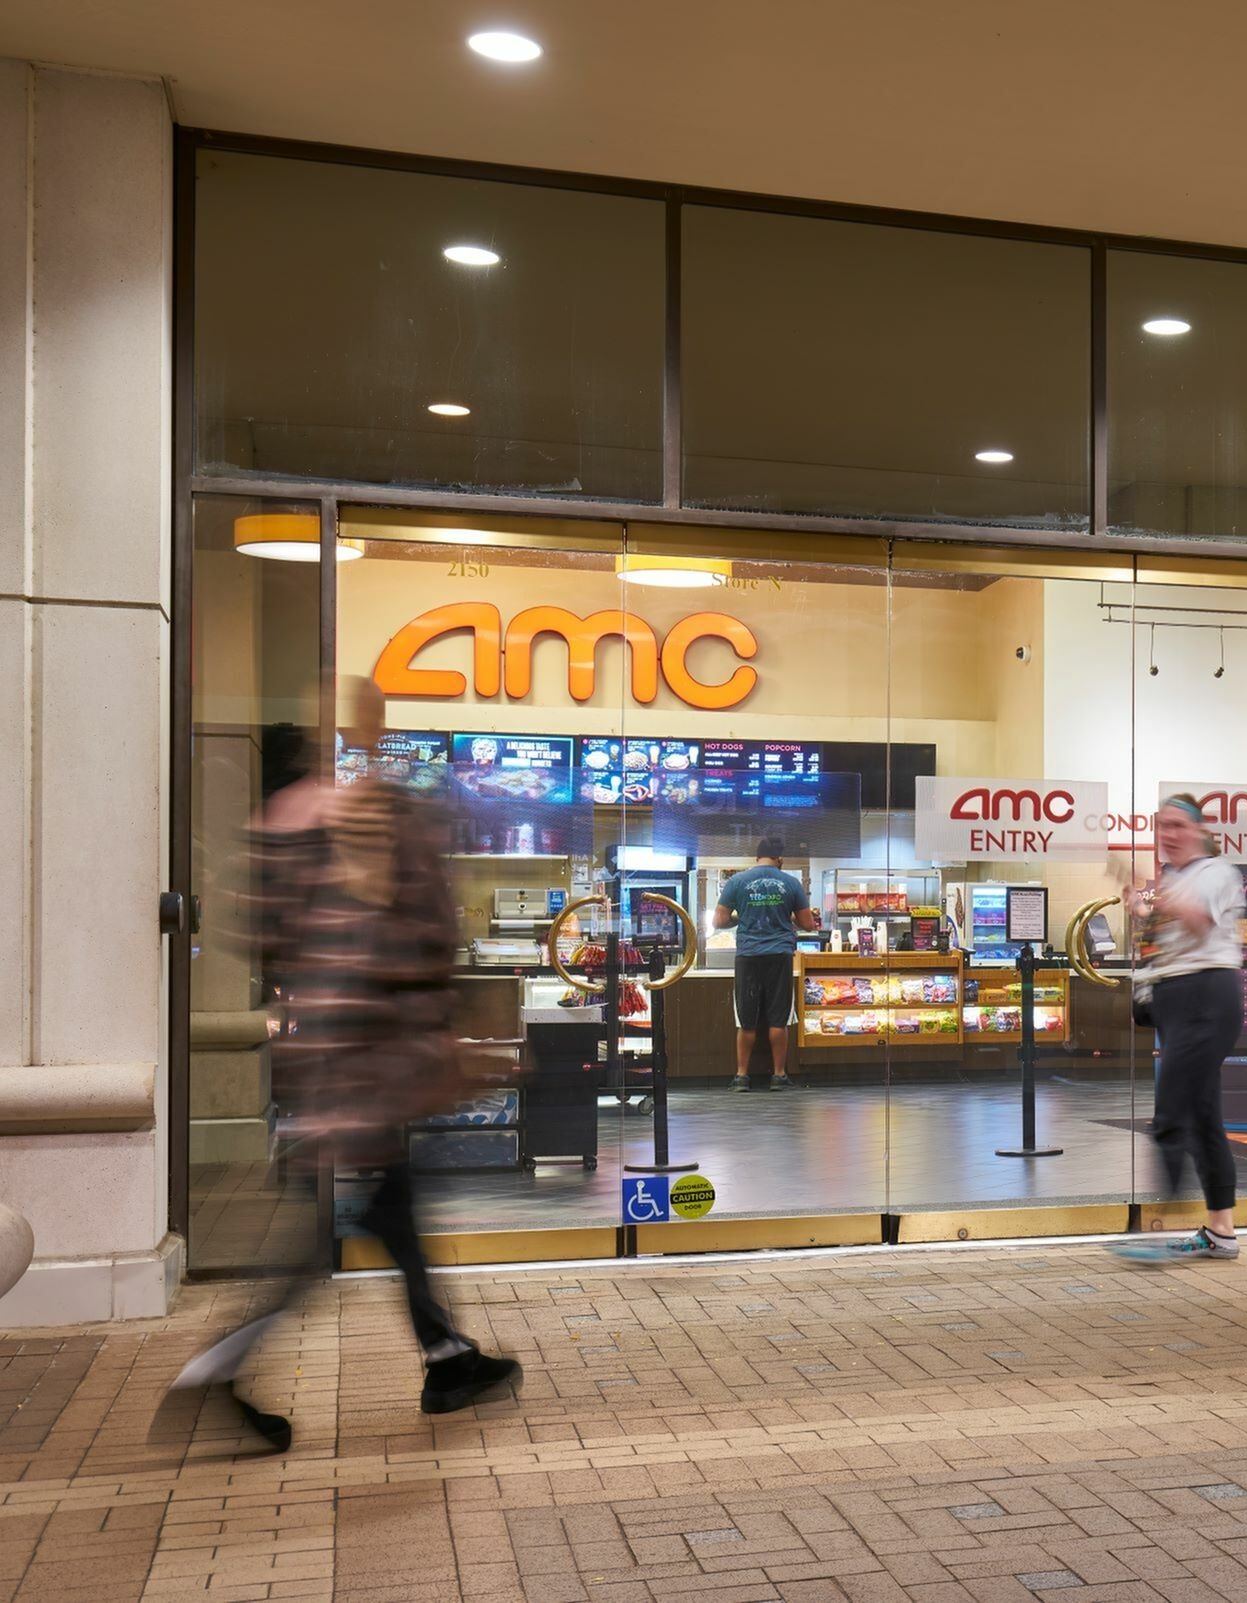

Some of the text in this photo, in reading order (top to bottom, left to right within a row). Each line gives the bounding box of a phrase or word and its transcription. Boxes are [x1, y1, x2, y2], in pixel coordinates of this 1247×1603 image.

[447, 561, 489, 578] 2150
[712, 573, 758, 590] Store
[378, 742, 417, 751] LATBREAD
[722, 743, 743, 751] DOGS
[765, 744, 801, 752] POPCORN
[1083, 814, 1155, 832] CONDI
[970, 829, 1053, 853] ENTRY
[675, 1183, 709, 1191] AUTOMATIC
[672, 1191, 713, 1203] CAUTION
[684, 1203, 702, 1211] DOOR
